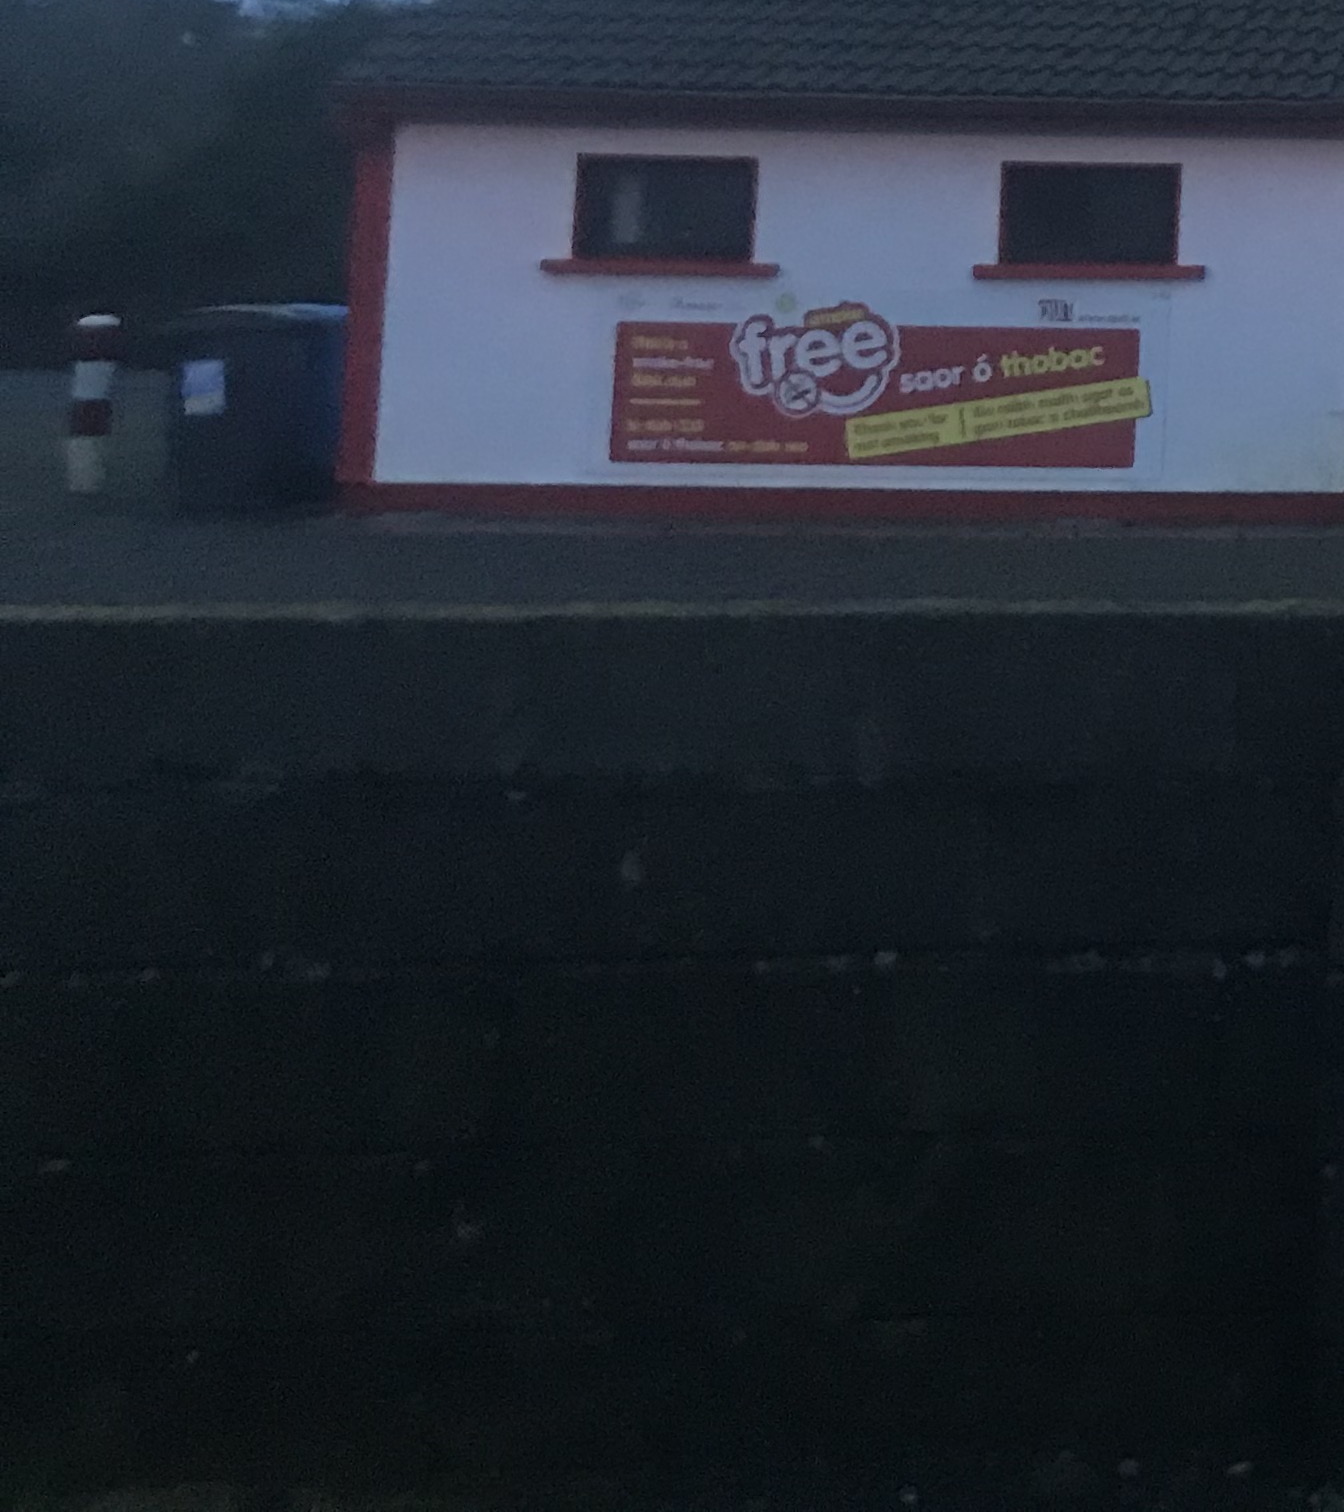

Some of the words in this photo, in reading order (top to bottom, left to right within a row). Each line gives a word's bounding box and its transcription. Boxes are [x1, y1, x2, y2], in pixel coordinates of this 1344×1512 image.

[739, 320, 889, 384] free
[899, 365, 965, 394] saor
[972, 354, 994, 384] ó
[1001, 345, 1105, 378] thobac
